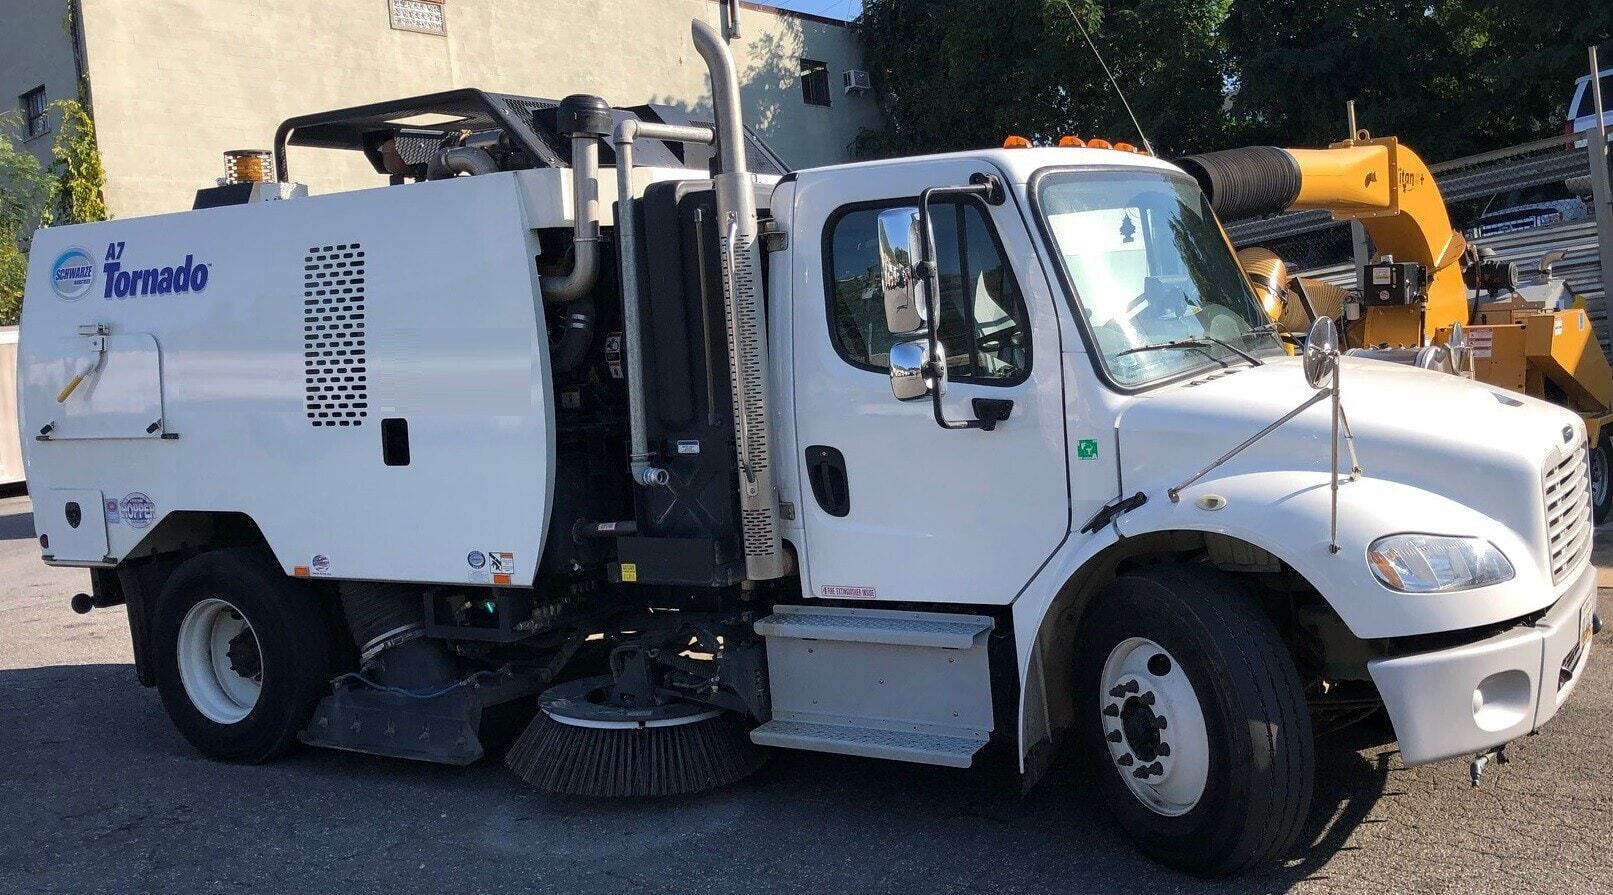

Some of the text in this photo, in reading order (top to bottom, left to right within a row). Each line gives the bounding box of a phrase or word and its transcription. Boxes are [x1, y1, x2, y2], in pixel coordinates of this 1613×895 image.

[105, 241, 125, 261] A7
[55, 265, 93, 281] SCHWARZE
[103, 254, 209, 298] Tornado
